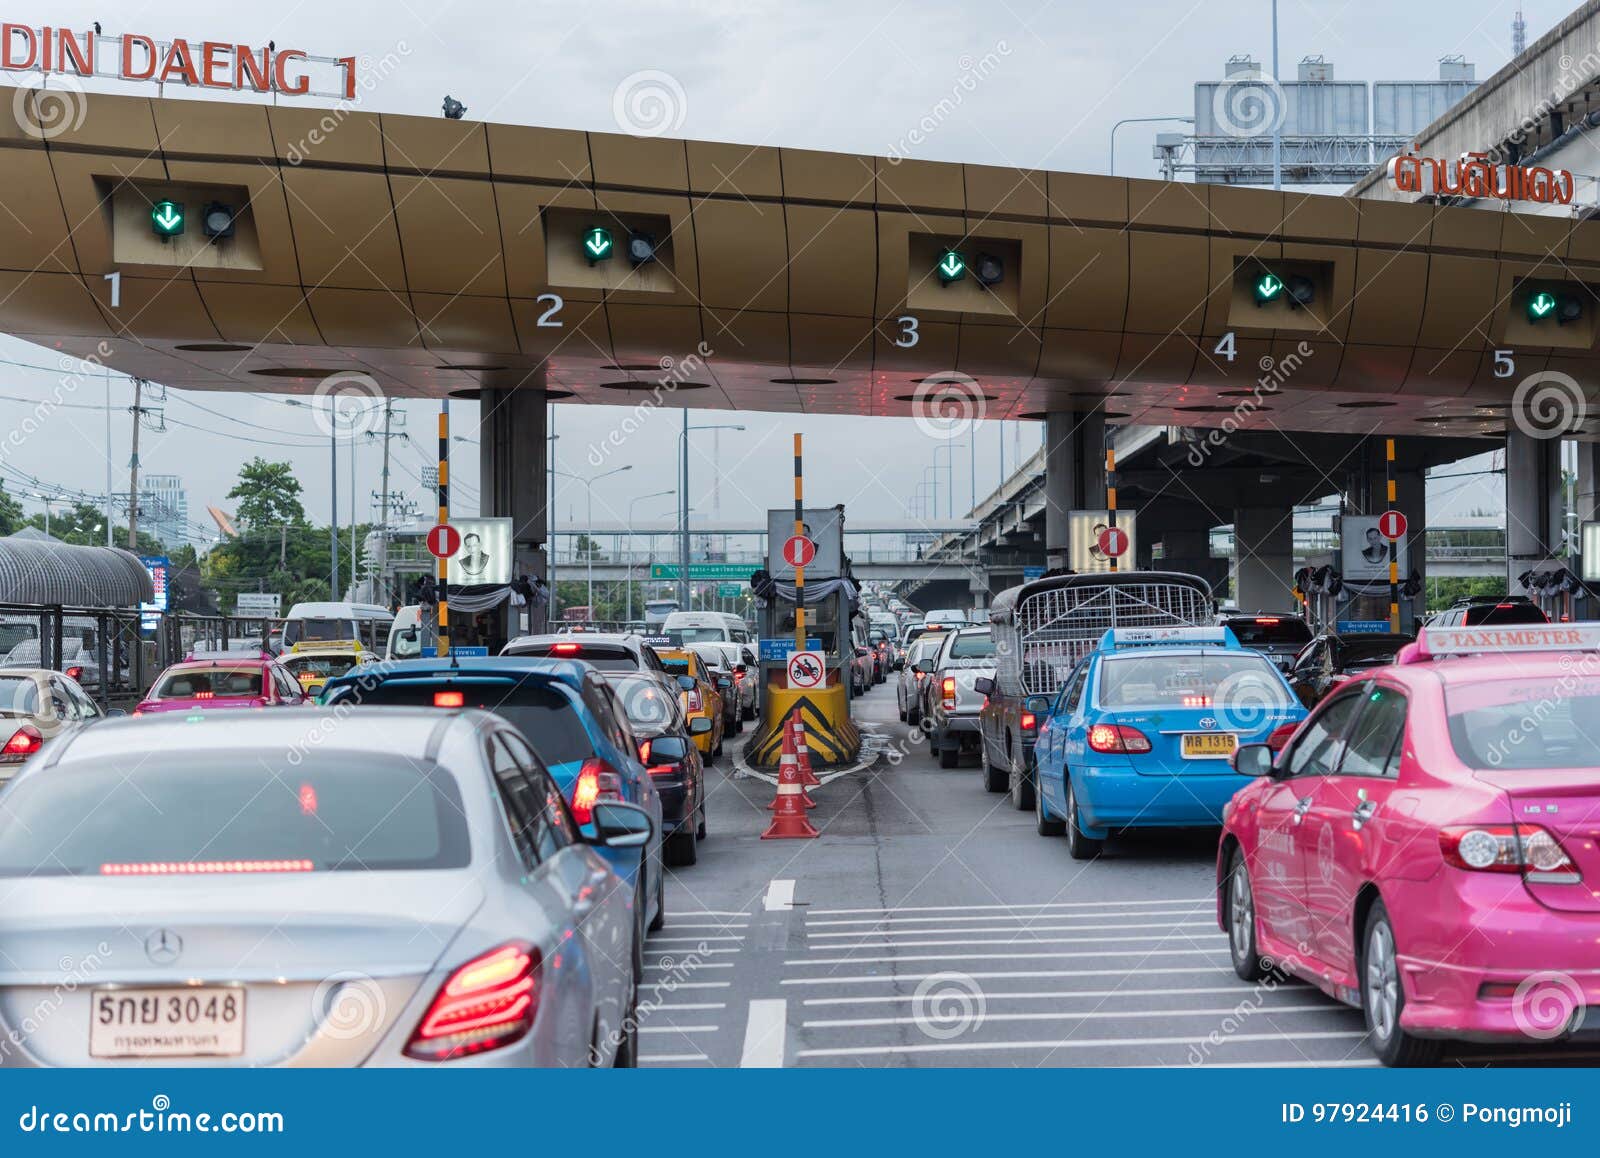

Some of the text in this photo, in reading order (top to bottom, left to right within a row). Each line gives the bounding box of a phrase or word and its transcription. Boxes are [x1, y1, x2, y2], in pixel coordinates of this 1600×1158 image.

[1, 22, 357, 101] DIN DAENG 1
[1390, 143, 1575, 205] ด่านดินแดง
[103, 271, 122, 308] 1
[536, 293, 564, 328] 2
[895, 316, 920, 348] 3
[1213, 332, 1238, 362] 4
[1493, 349, 1516, 378] 5
[1450, 629, 1583, 648] TAXI-METER
[1208, 735, 1235, 748] 1315
[167, 993, 237, 1024] 3048
